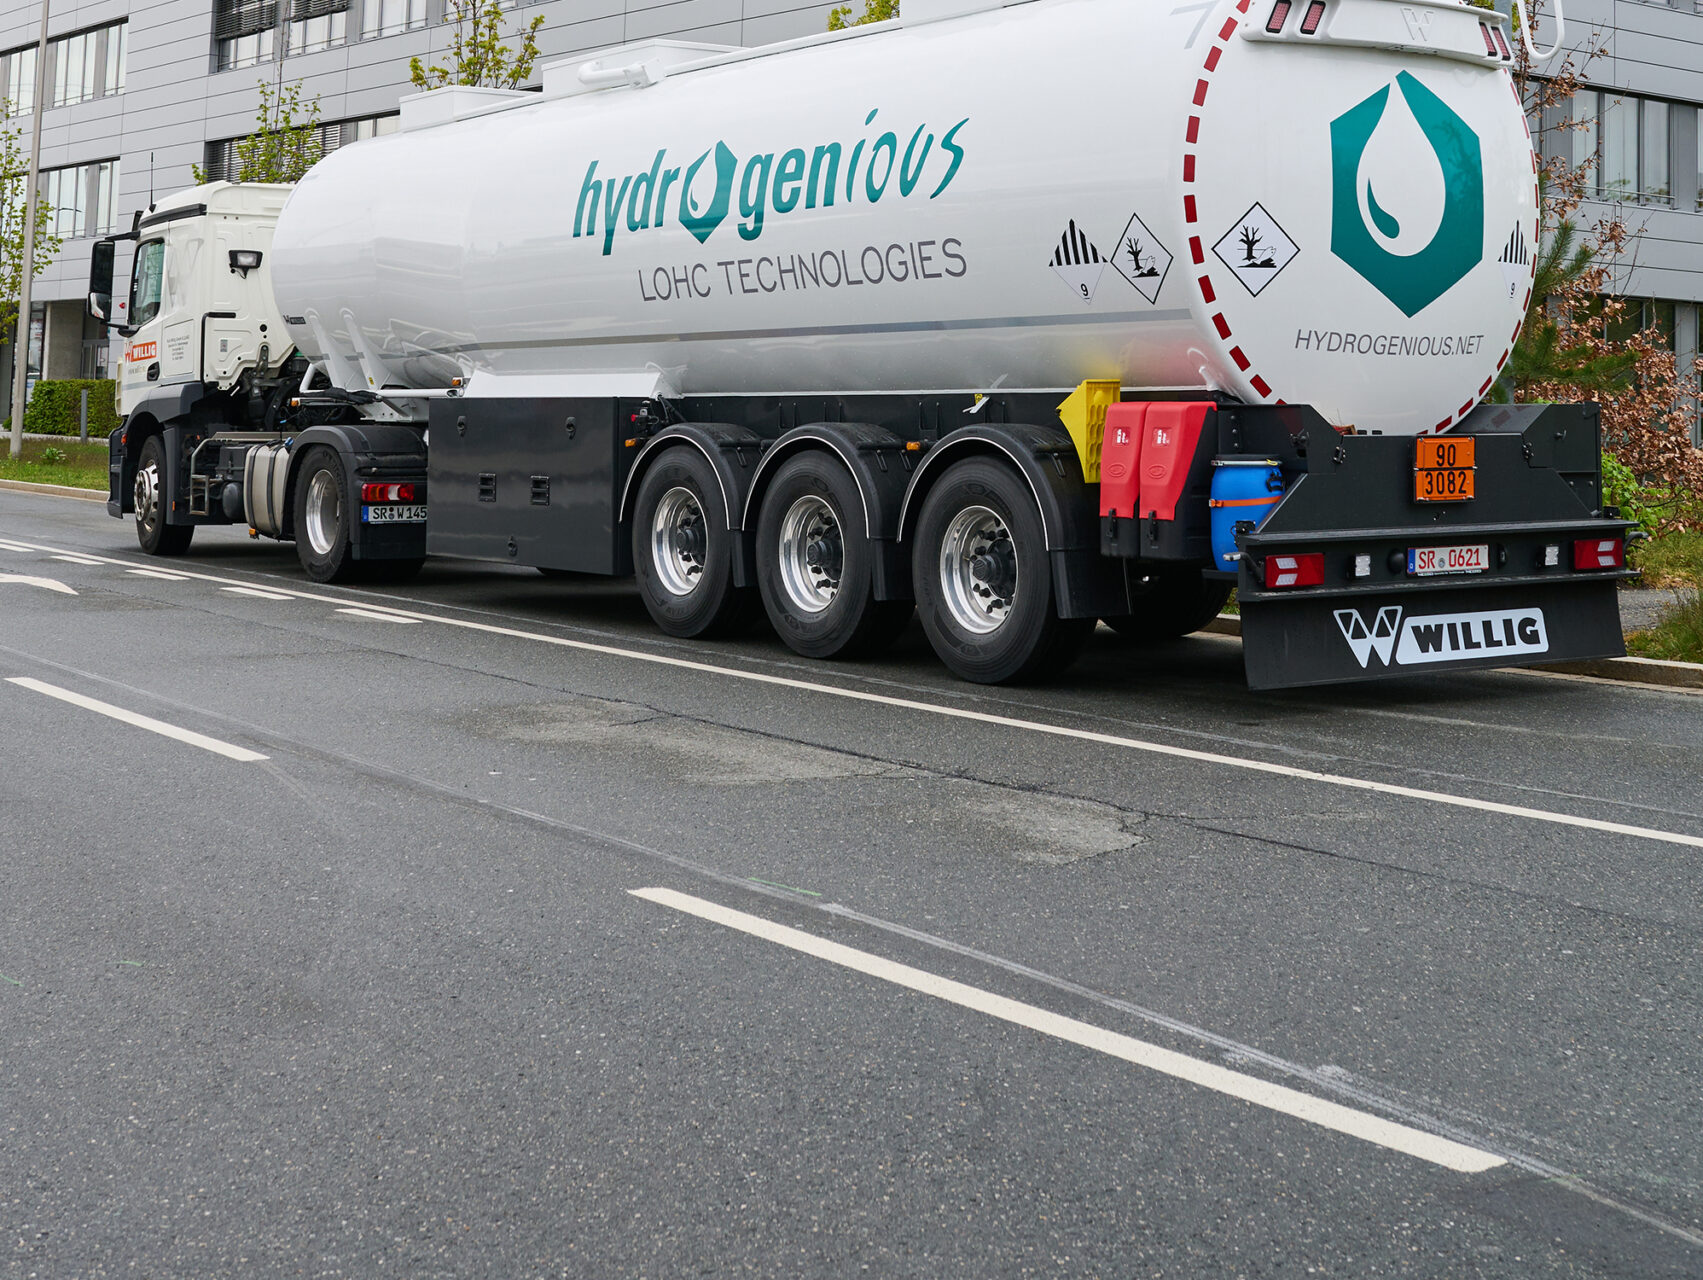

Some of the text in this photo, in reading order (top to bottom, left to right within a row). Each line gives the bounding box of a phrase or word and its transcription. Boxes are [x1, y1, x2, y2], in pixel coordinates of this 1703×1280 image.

[638, 237, 967, 302] LOHC TECHNOLOGIES
[1080, 283, 1089, 297] 9
[132, 343, 156, 360] WILLIG
[1295, 328, 1485, 357] HYDROGENIOUS.NET
[1436, 443, 1457, 467] 90
[1425, 470, 1468, 495] 3082
[373, 507, 388, 520] SR
[1418, 550, 1436, 569] SR
[1448, 547, 1482, 568] 0621
[1411, 616, 1541, 654] WILLIG
